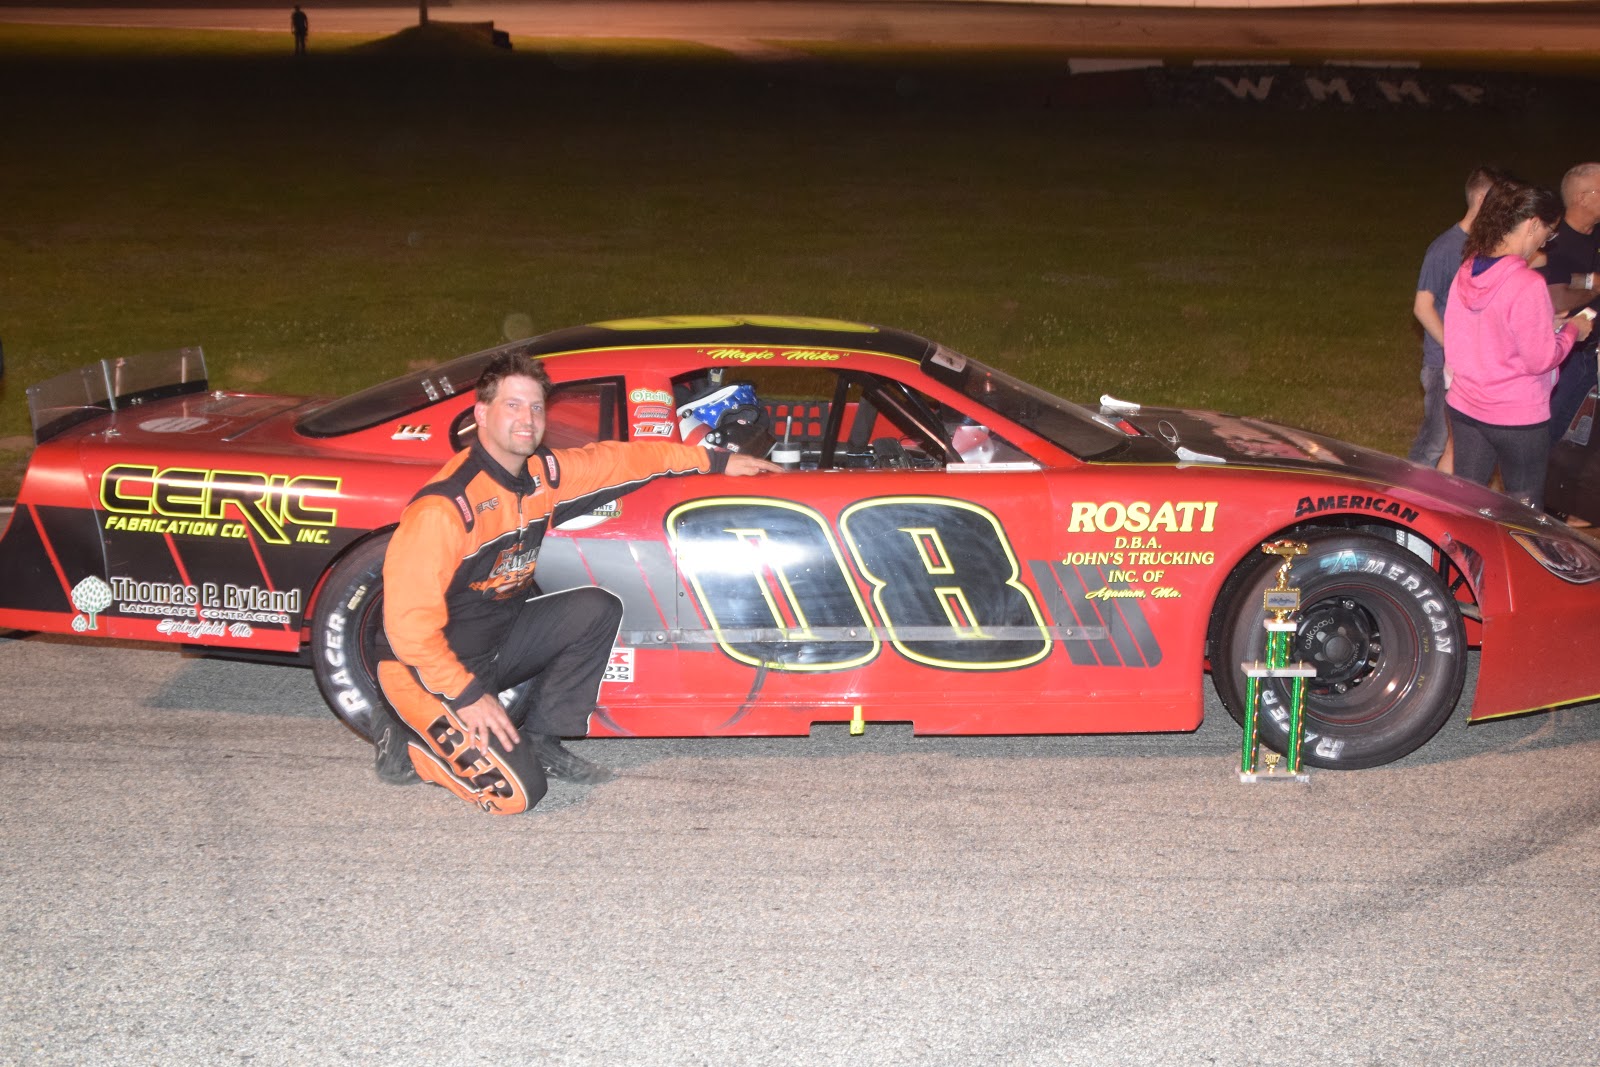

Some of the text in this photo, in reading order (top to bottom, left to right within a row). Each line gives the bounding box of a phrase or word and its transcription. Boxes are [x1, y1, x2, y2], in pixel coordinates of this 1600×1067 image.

[100, 463, 343, 545] CERIC
[1067, 501, 1219, 533] ROSATI
[1296, 496, 1420, 524] AMERICAN
[105, 515, 331, 544] FABRICATION CO. INC.
[1114, 536, 1163, 549] D.B.A.
[1062, 551, 1215, 566] JOHN'S TRUCKING
[1107, 570, 1165, 583] INC. OF
[111, 577, 300, 614] Thomas P. Ryland
[119, 603, 291, 624] LANDSCAPE CONTRACTOR
[325, 612, 369, 716] RACER
